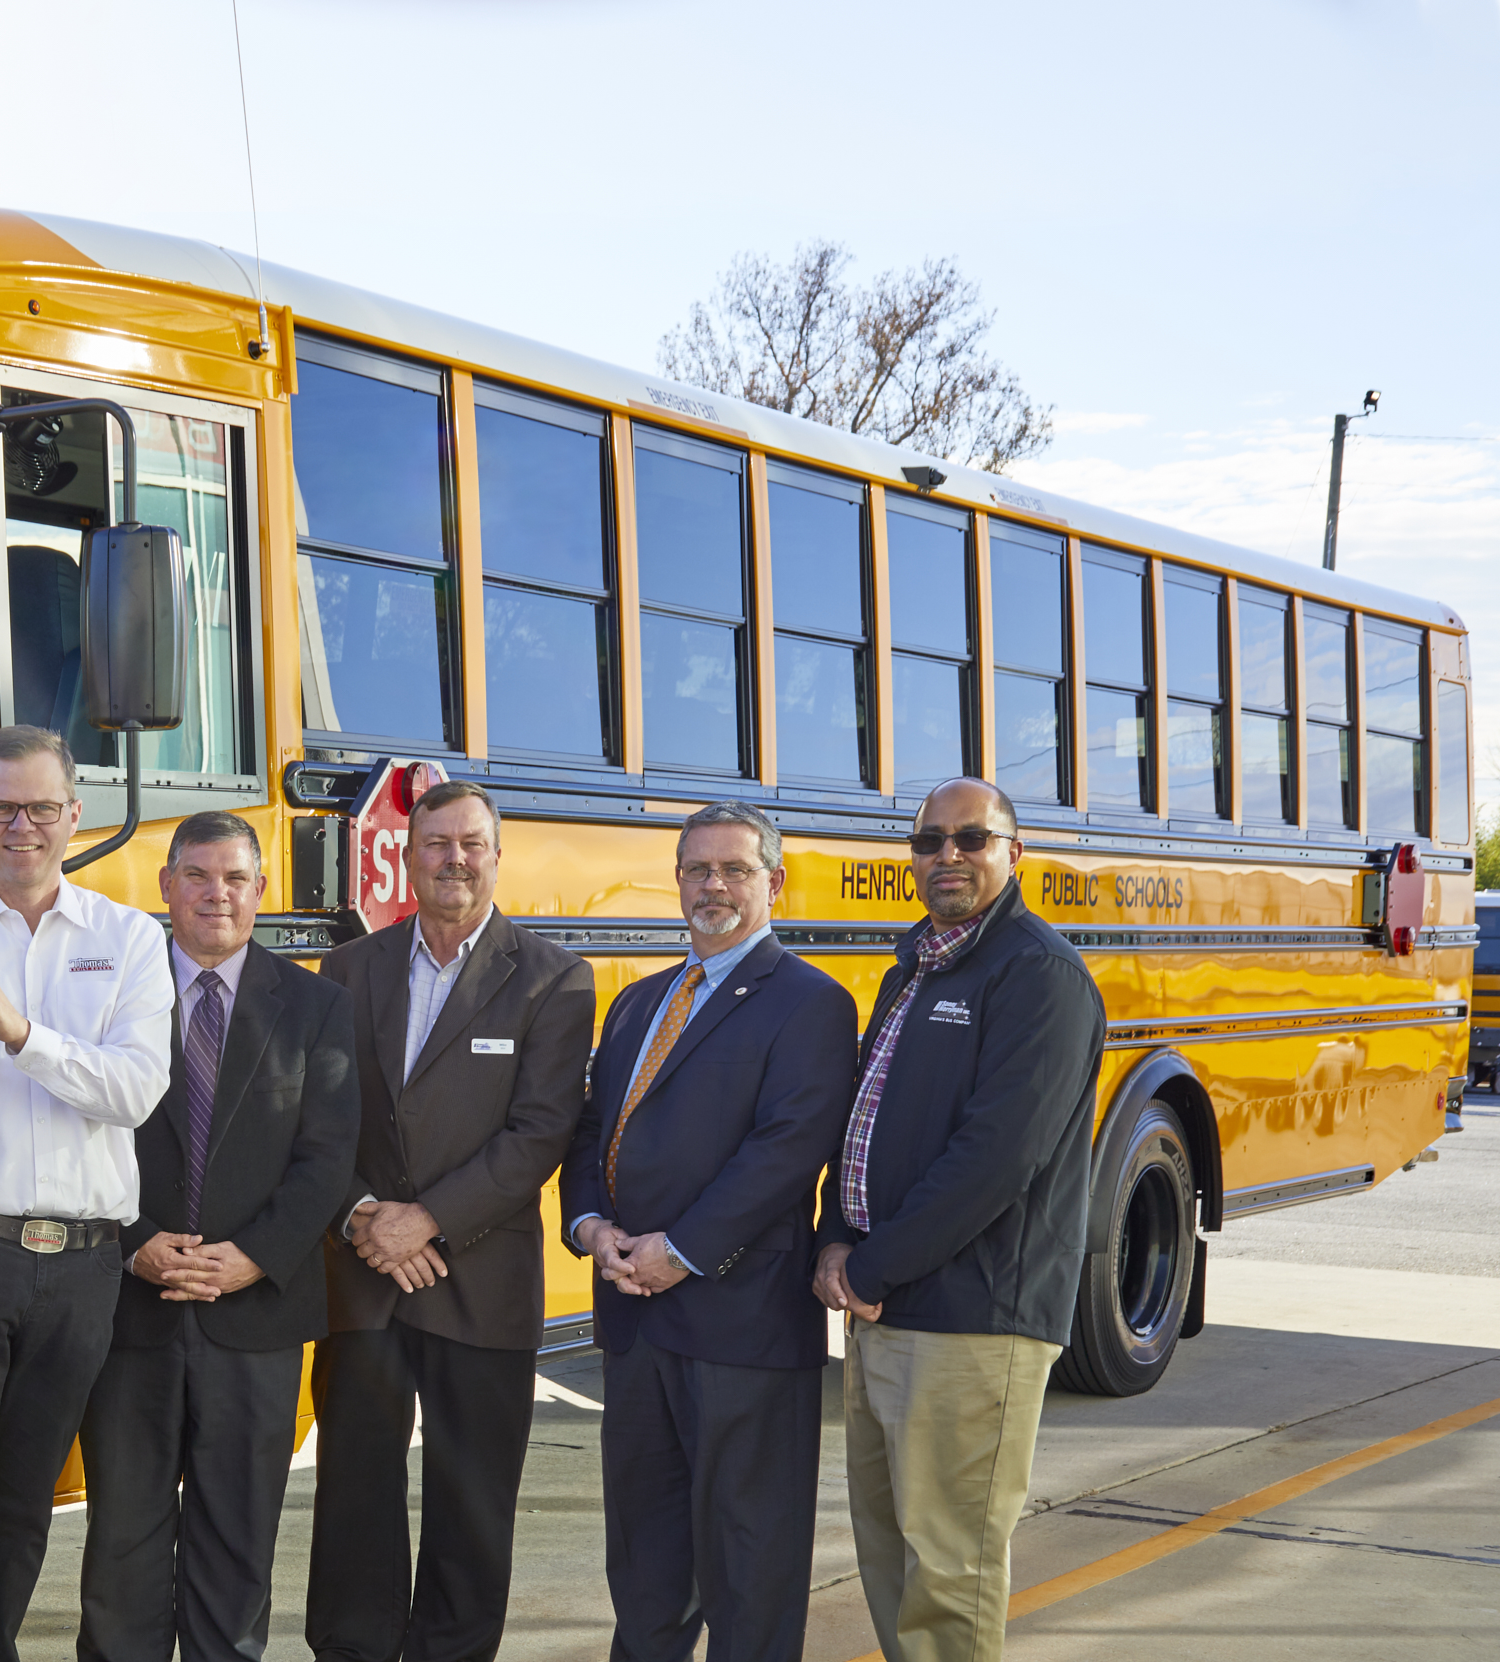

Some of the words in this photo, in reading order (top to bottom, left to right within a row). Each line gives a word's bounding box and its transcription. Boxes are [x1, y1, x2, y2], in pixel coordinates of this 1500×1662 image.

[646, 386, 701, 417] EMERGENCY
[698, 402, 720, 422] EXIT
[372, 829, 418, 903] ST
[841, 861, 923, 902] HENRIC
[1042, 872, 1098, 906] PUBLIC
[1115, 875, 1183, 909] SCHOOLS
[68, 957, 113, 968] Thomas
[28, 1229, 62, 1240] Thomas
